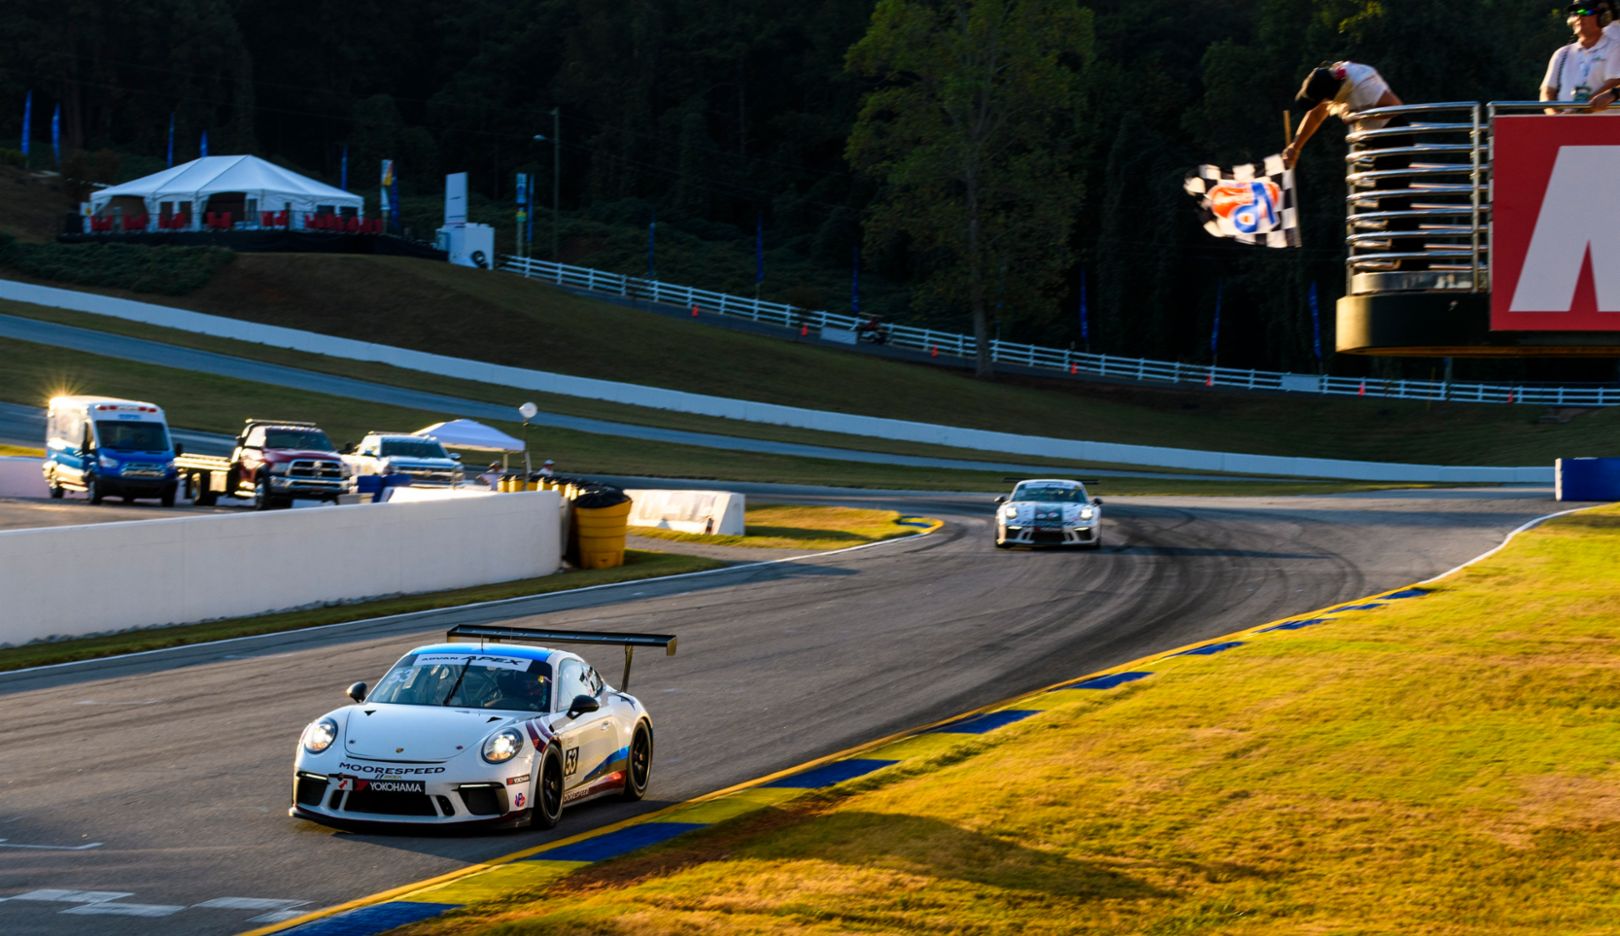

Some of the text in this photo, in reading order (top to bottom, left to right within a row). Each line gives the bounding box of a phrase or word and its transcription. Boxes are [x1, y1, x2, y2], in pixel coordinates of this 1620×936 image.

[460, 655, 525, 666] APEX
[565, 749, 577, 775] 53
[340, 762, 446, 775] MOORESPEED
[369, 781, 422, 793] YOKOHAMA
